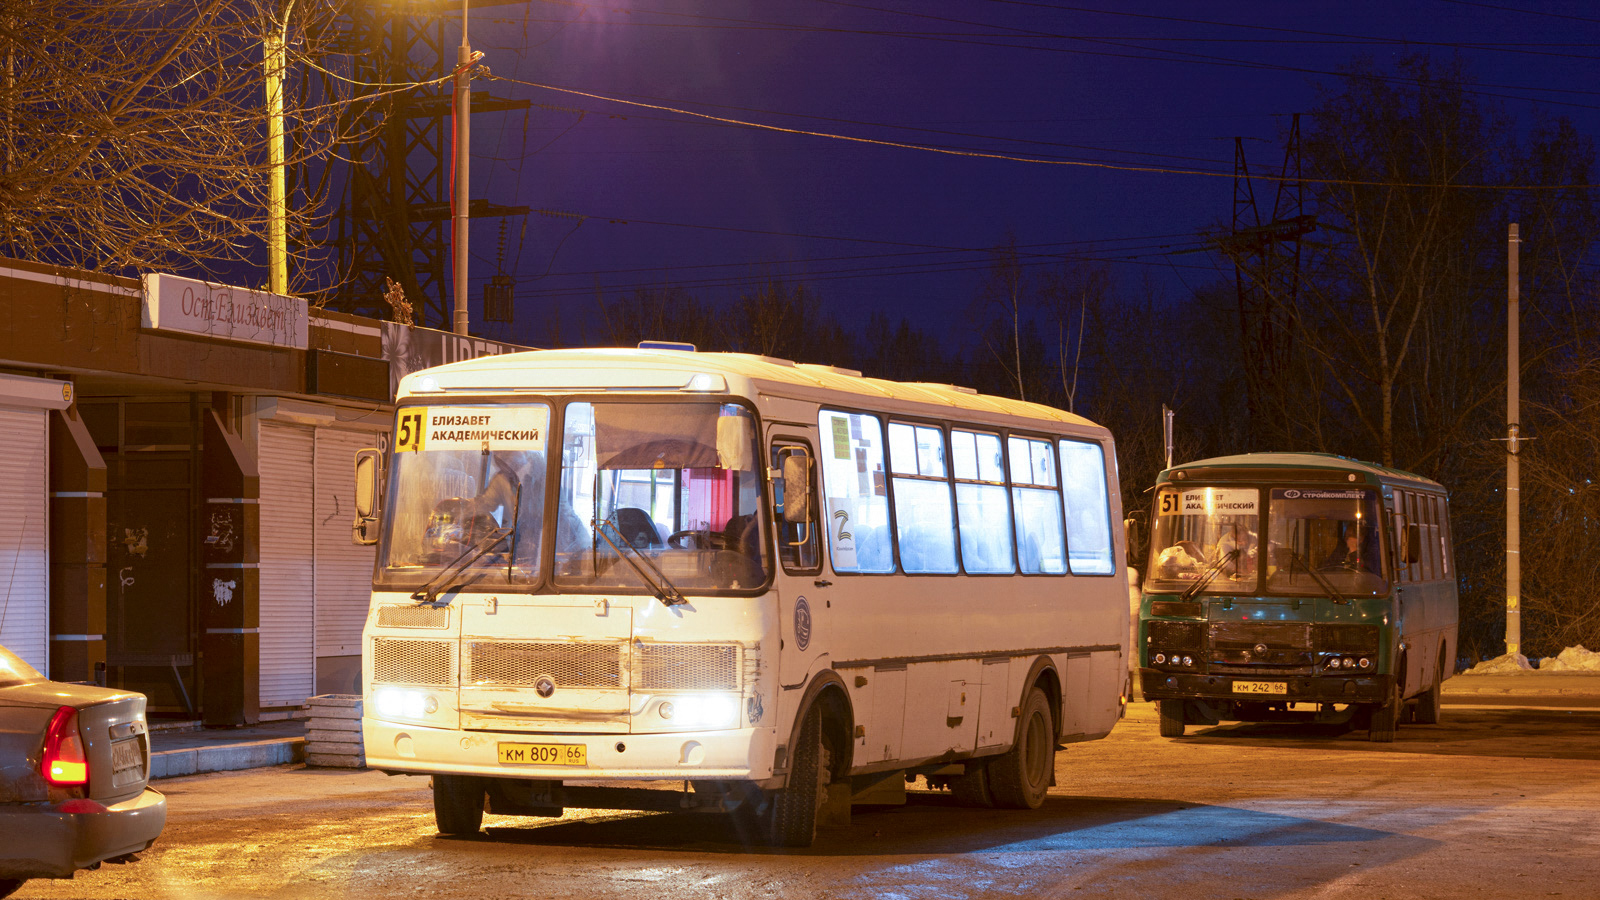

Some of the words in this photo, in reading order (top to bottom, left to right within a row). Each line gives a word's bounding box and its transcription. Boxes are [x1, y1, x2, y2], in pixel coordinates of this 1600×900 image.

[432, 416, 491, 426] ЕЛИЗАВЕТ
[398, 414, 422, 446] 51
[431, 428, 539, 442] АКАДЕМИЧЕСКИЙ
[1302, 491, 1366, 499] СТРОЙКОМПЛЕКТ
[1162, 494, 1179, 512] 51
[1185, 502, 1254, 510] АКАИЧЕСКИЙ
[1252, 683, 1270, 692] 242
[530, 747, 558, 762] 809
[566, 746, 581, 758] 66
